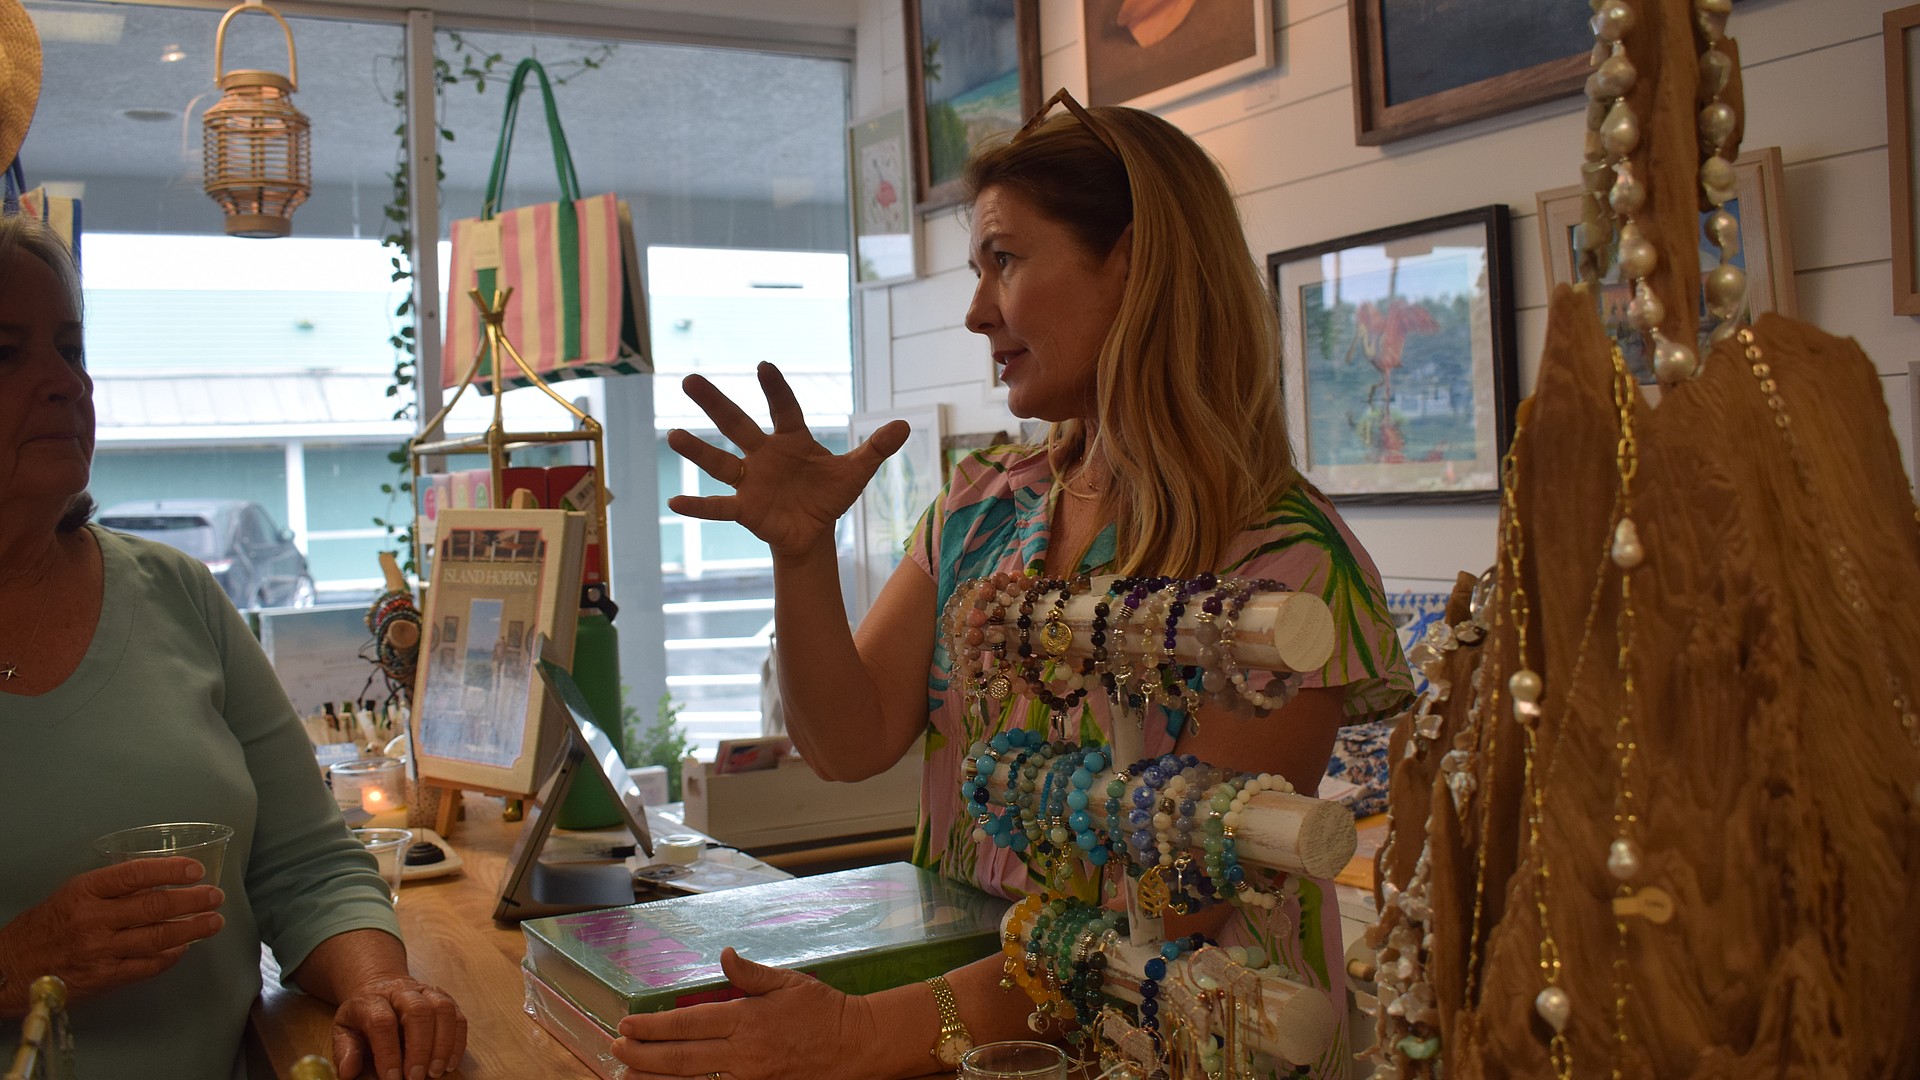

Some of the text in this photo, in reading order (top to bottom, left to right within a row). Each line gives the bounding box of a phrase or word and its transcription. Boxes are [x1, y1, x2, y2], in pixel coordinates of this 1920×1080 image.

[442, 567, 538, 587] ISLAND HOPPING
[555, 909, 723, 988] TULUM
